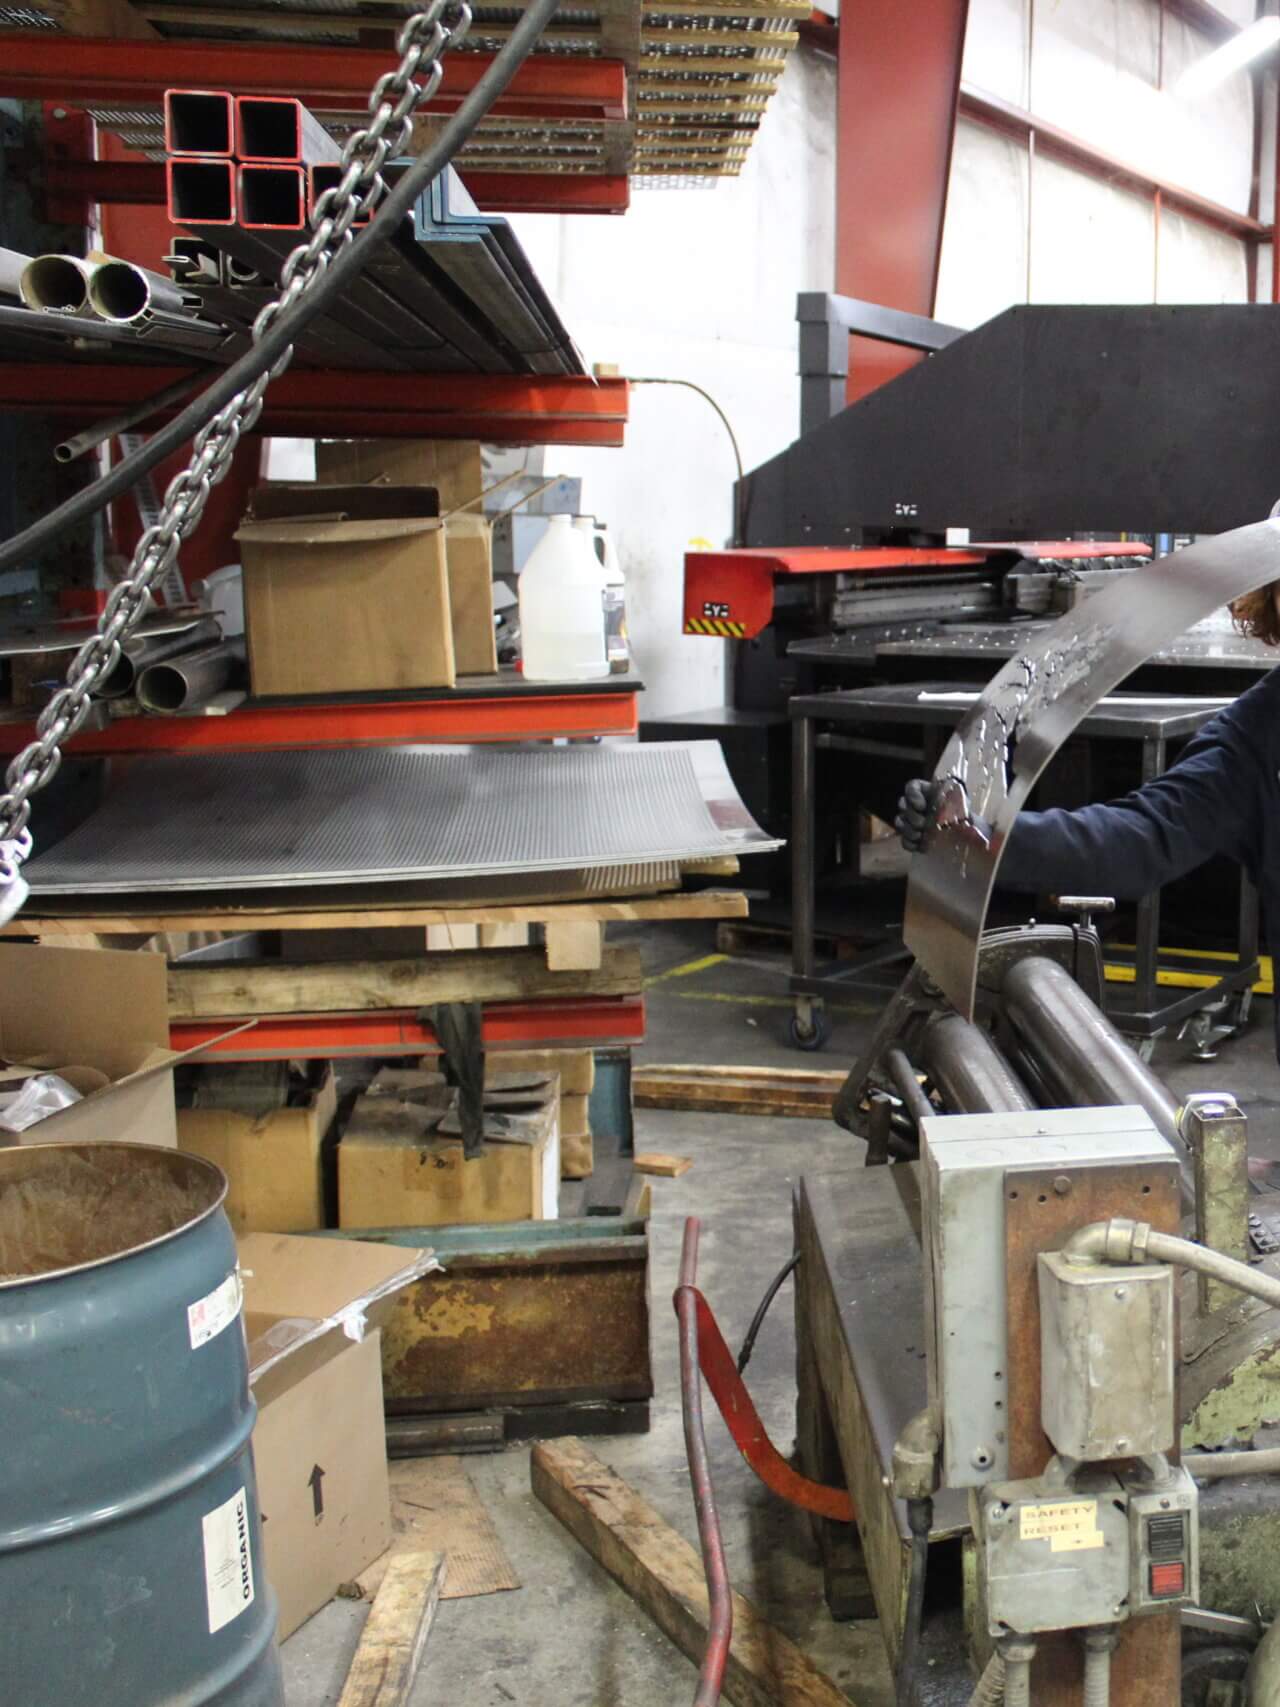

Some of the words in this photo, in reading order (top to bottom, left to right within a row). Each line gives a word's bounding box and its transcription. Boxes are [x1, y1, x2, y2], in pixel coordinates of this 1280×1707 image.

[1025, 1505, 1094, 1519] SAFETY
[1023, 1523, 1081, 1536] RESET
[236, 1501, 251, 1600] ORGANIC
